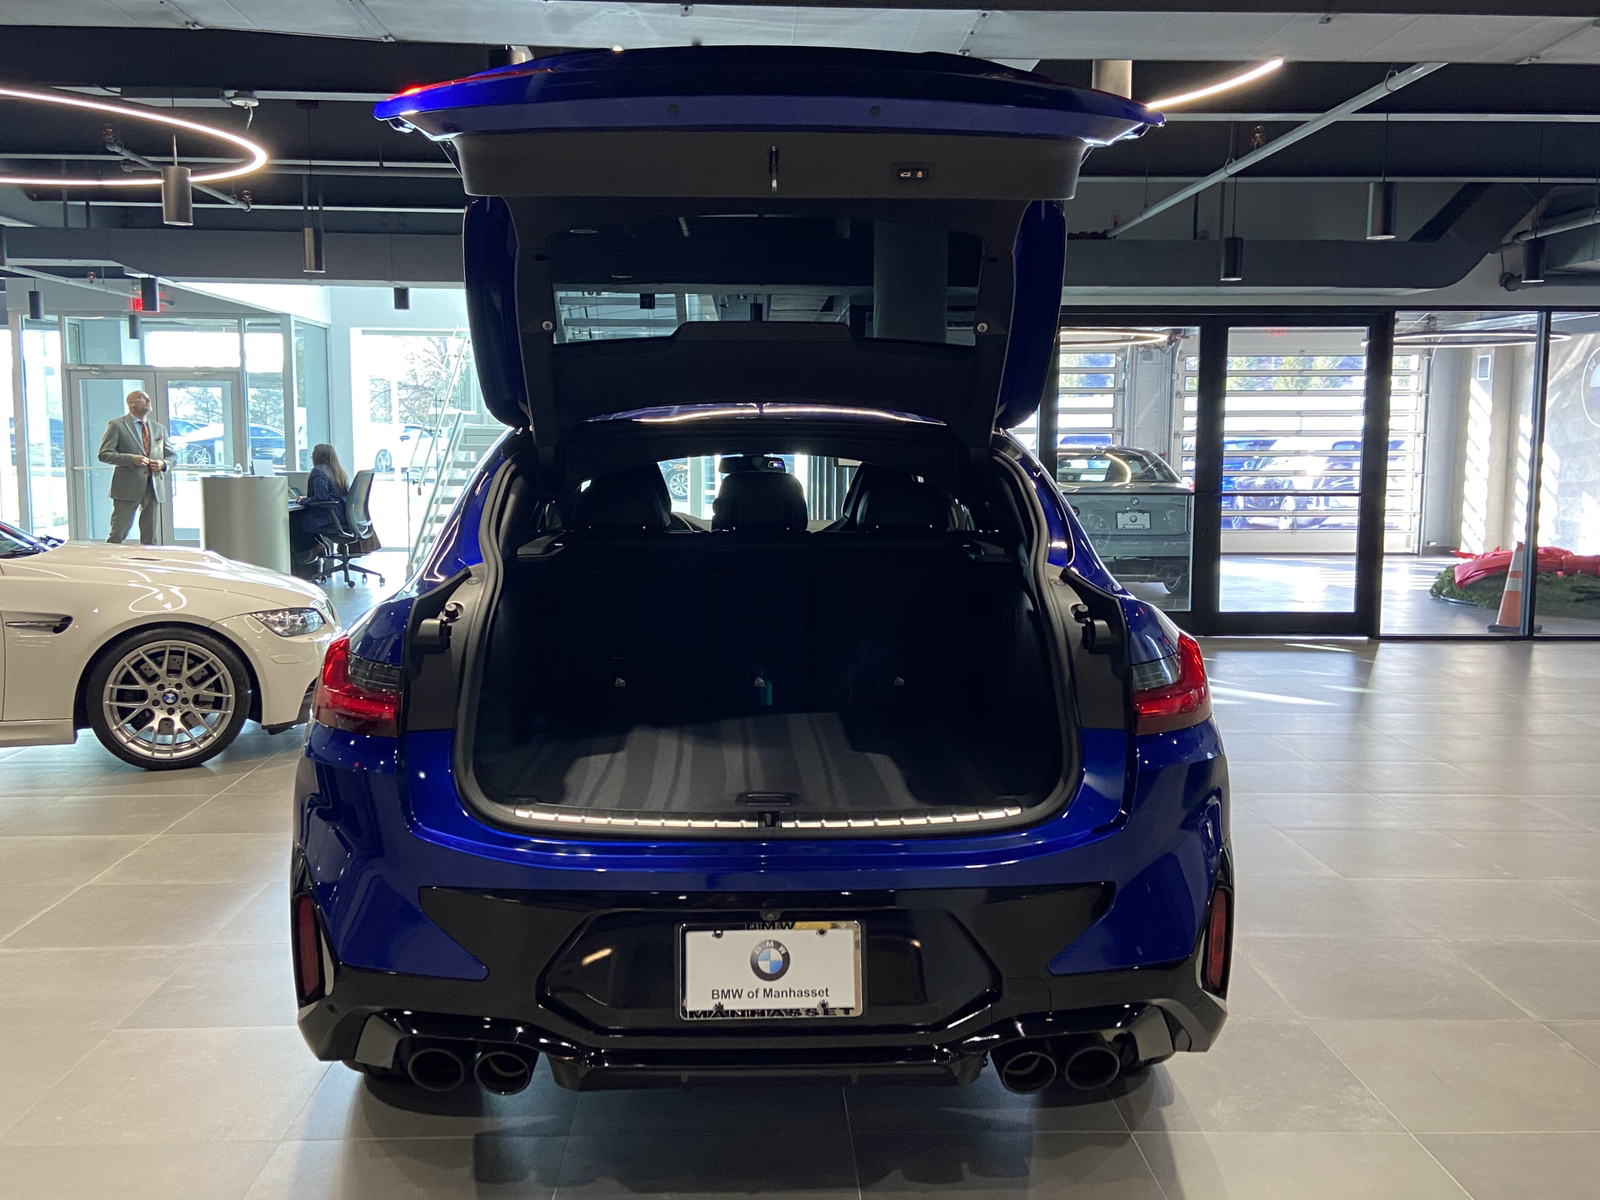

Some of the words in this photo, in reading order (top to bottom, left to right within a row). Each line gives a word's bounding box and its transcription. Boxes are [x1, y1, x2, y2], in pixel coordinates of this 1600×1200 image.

[754, 940, 787, 955] BMW
[711, 988, 743, 1000] BMW
[747, 988, 759, 999] of
[763, 987, 830, 999] Manhasset
